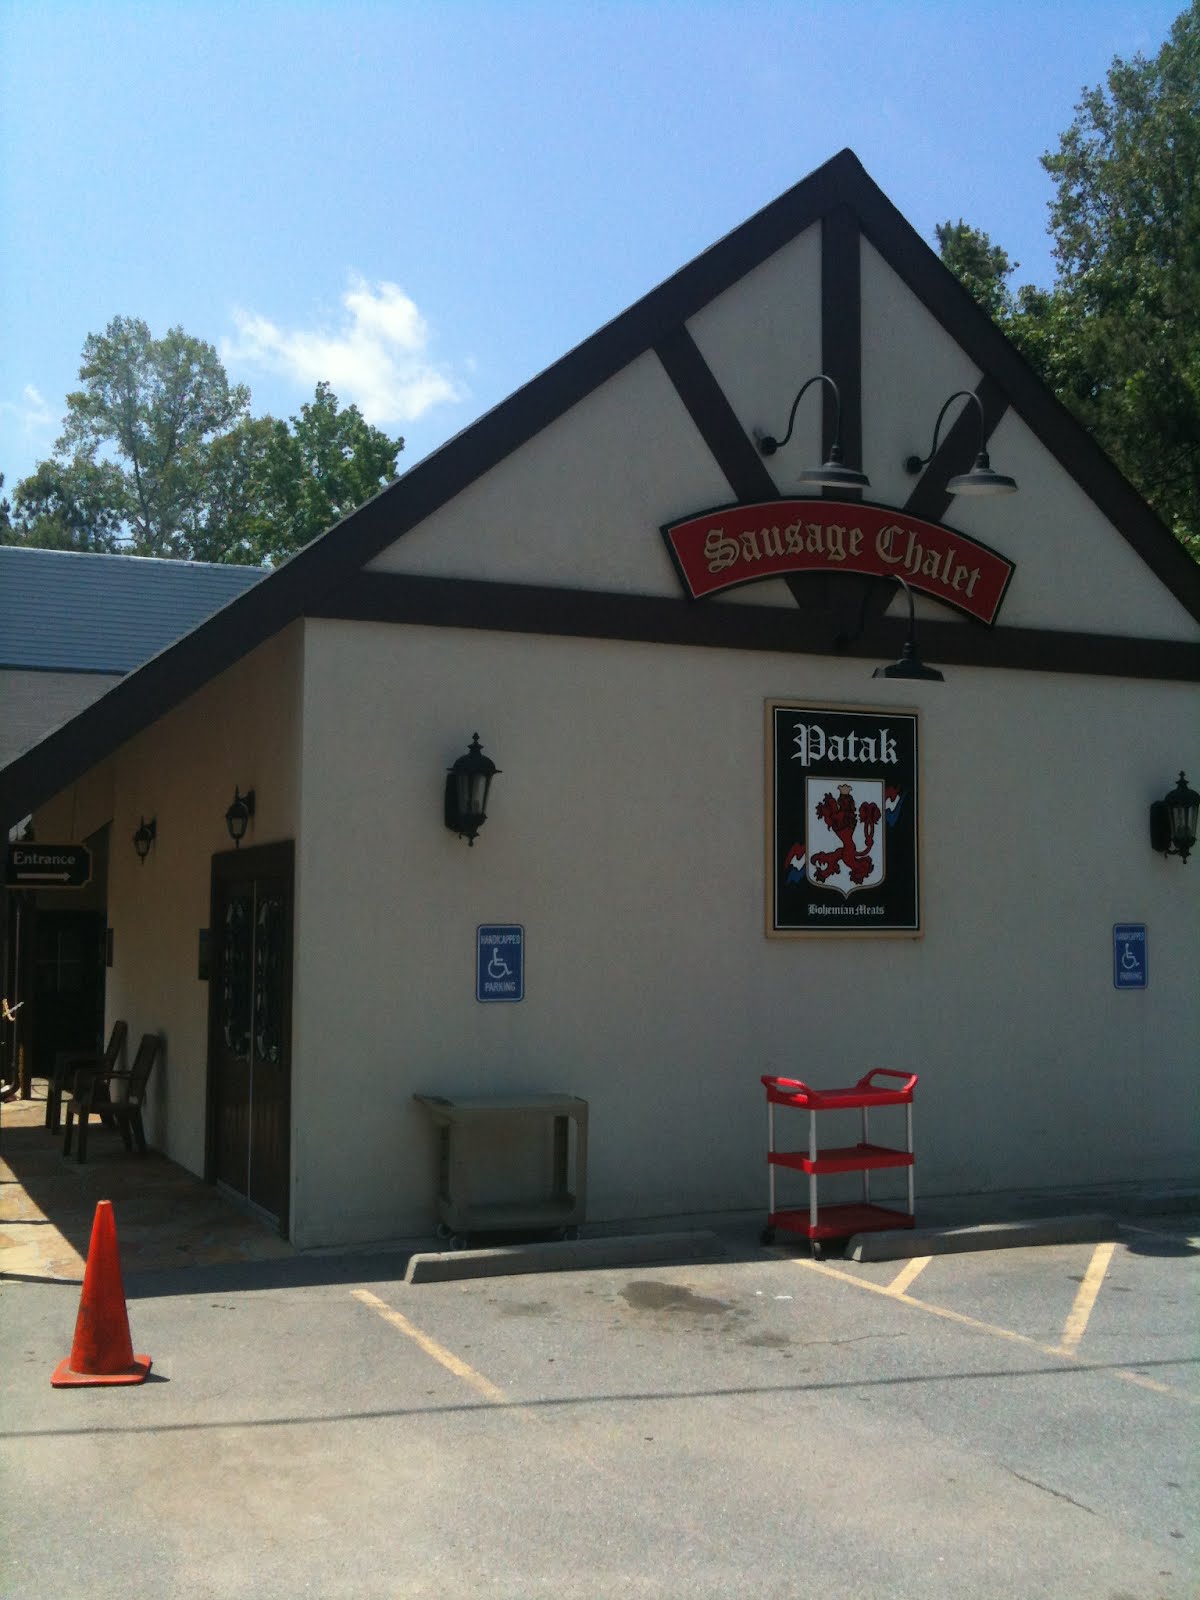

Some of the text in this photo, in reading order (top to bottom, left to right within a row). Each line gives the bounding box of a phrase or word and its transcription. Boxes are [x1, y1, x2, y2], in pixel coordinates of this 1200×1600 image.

[703, 519, 982, 599] Sausage Chalet
[790, 722, 899, 767] Patak
[13, 850, 76, 865] Entrance
[807, 903, 885, 916] Bohemian Meats
[484, 981, 516, 992] PARKING
